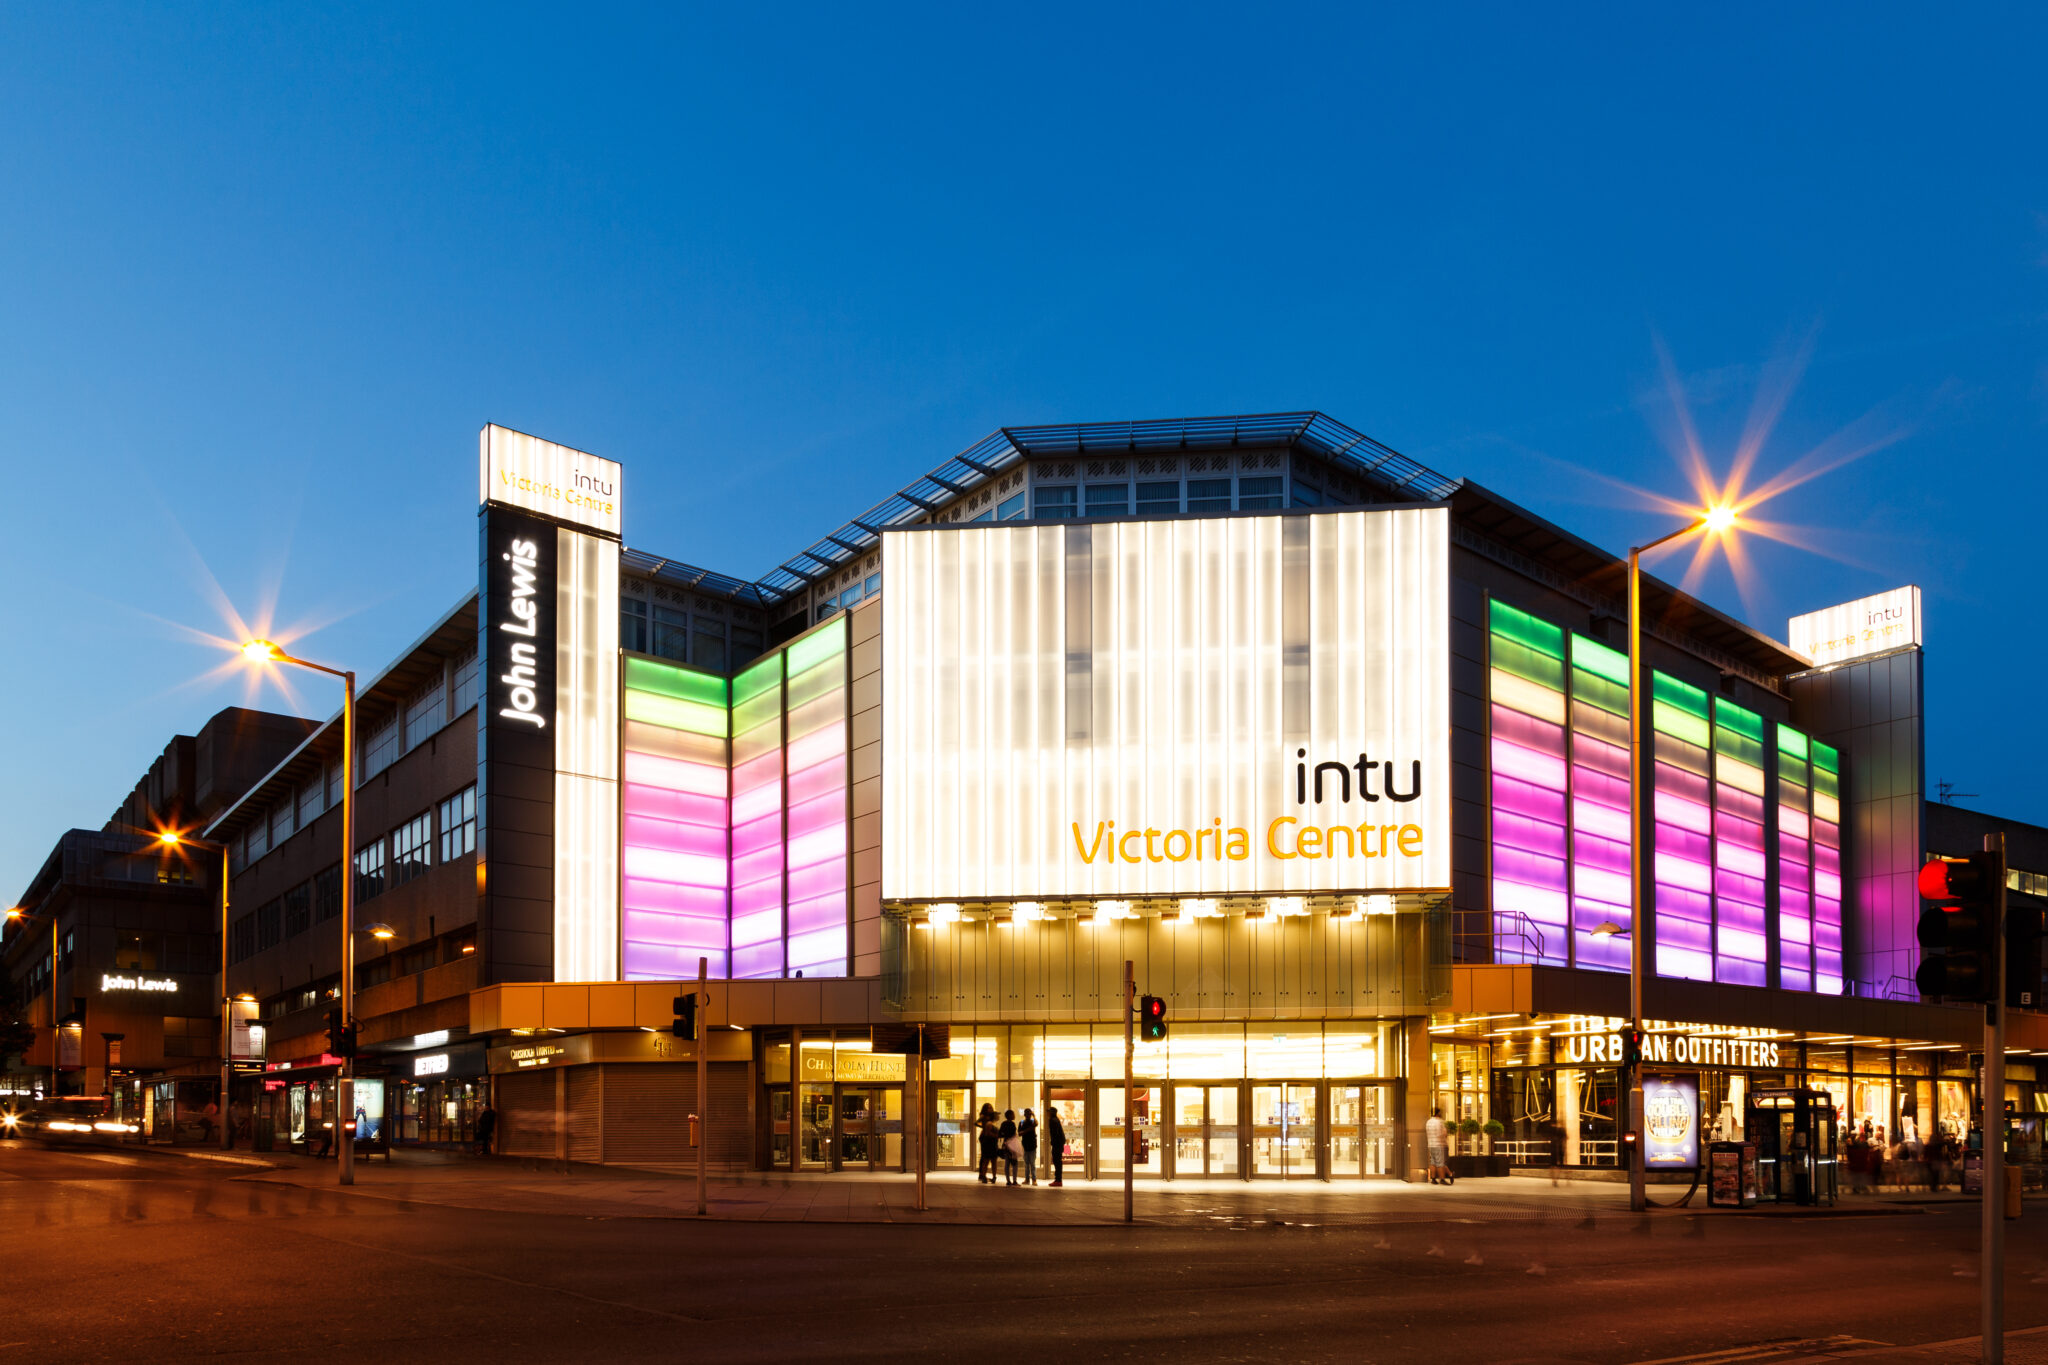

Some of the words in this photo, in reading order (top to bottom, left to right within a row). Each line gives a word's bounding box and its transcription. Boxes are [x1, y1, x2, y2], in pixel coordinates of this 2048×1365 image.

[500, 468, 561, 500] Victoria
[565, 489, 614, 515] Centre
[574, 468, 612, 496] intu
[499, 538, 537, 637] Lewis
[1868, 606, 1903, 625] intu
[1809, 633, 1856, 655] Victoria
[499, 641, 546, 729] John
[1297, 747, 1421, 805] intu
[1071, 816, 1250, 864] Victoria
[1267, 815, 1423, 859] Centre
[101, 974, 136, 992] John
[137, 976, 178, 992] Lewis
[1569, 1034, 1668, 1063] URBAN
[1674, 1036, 1779, 1067] OUTFITTERS
[825, 1071, 856, 1080] DIMOND
